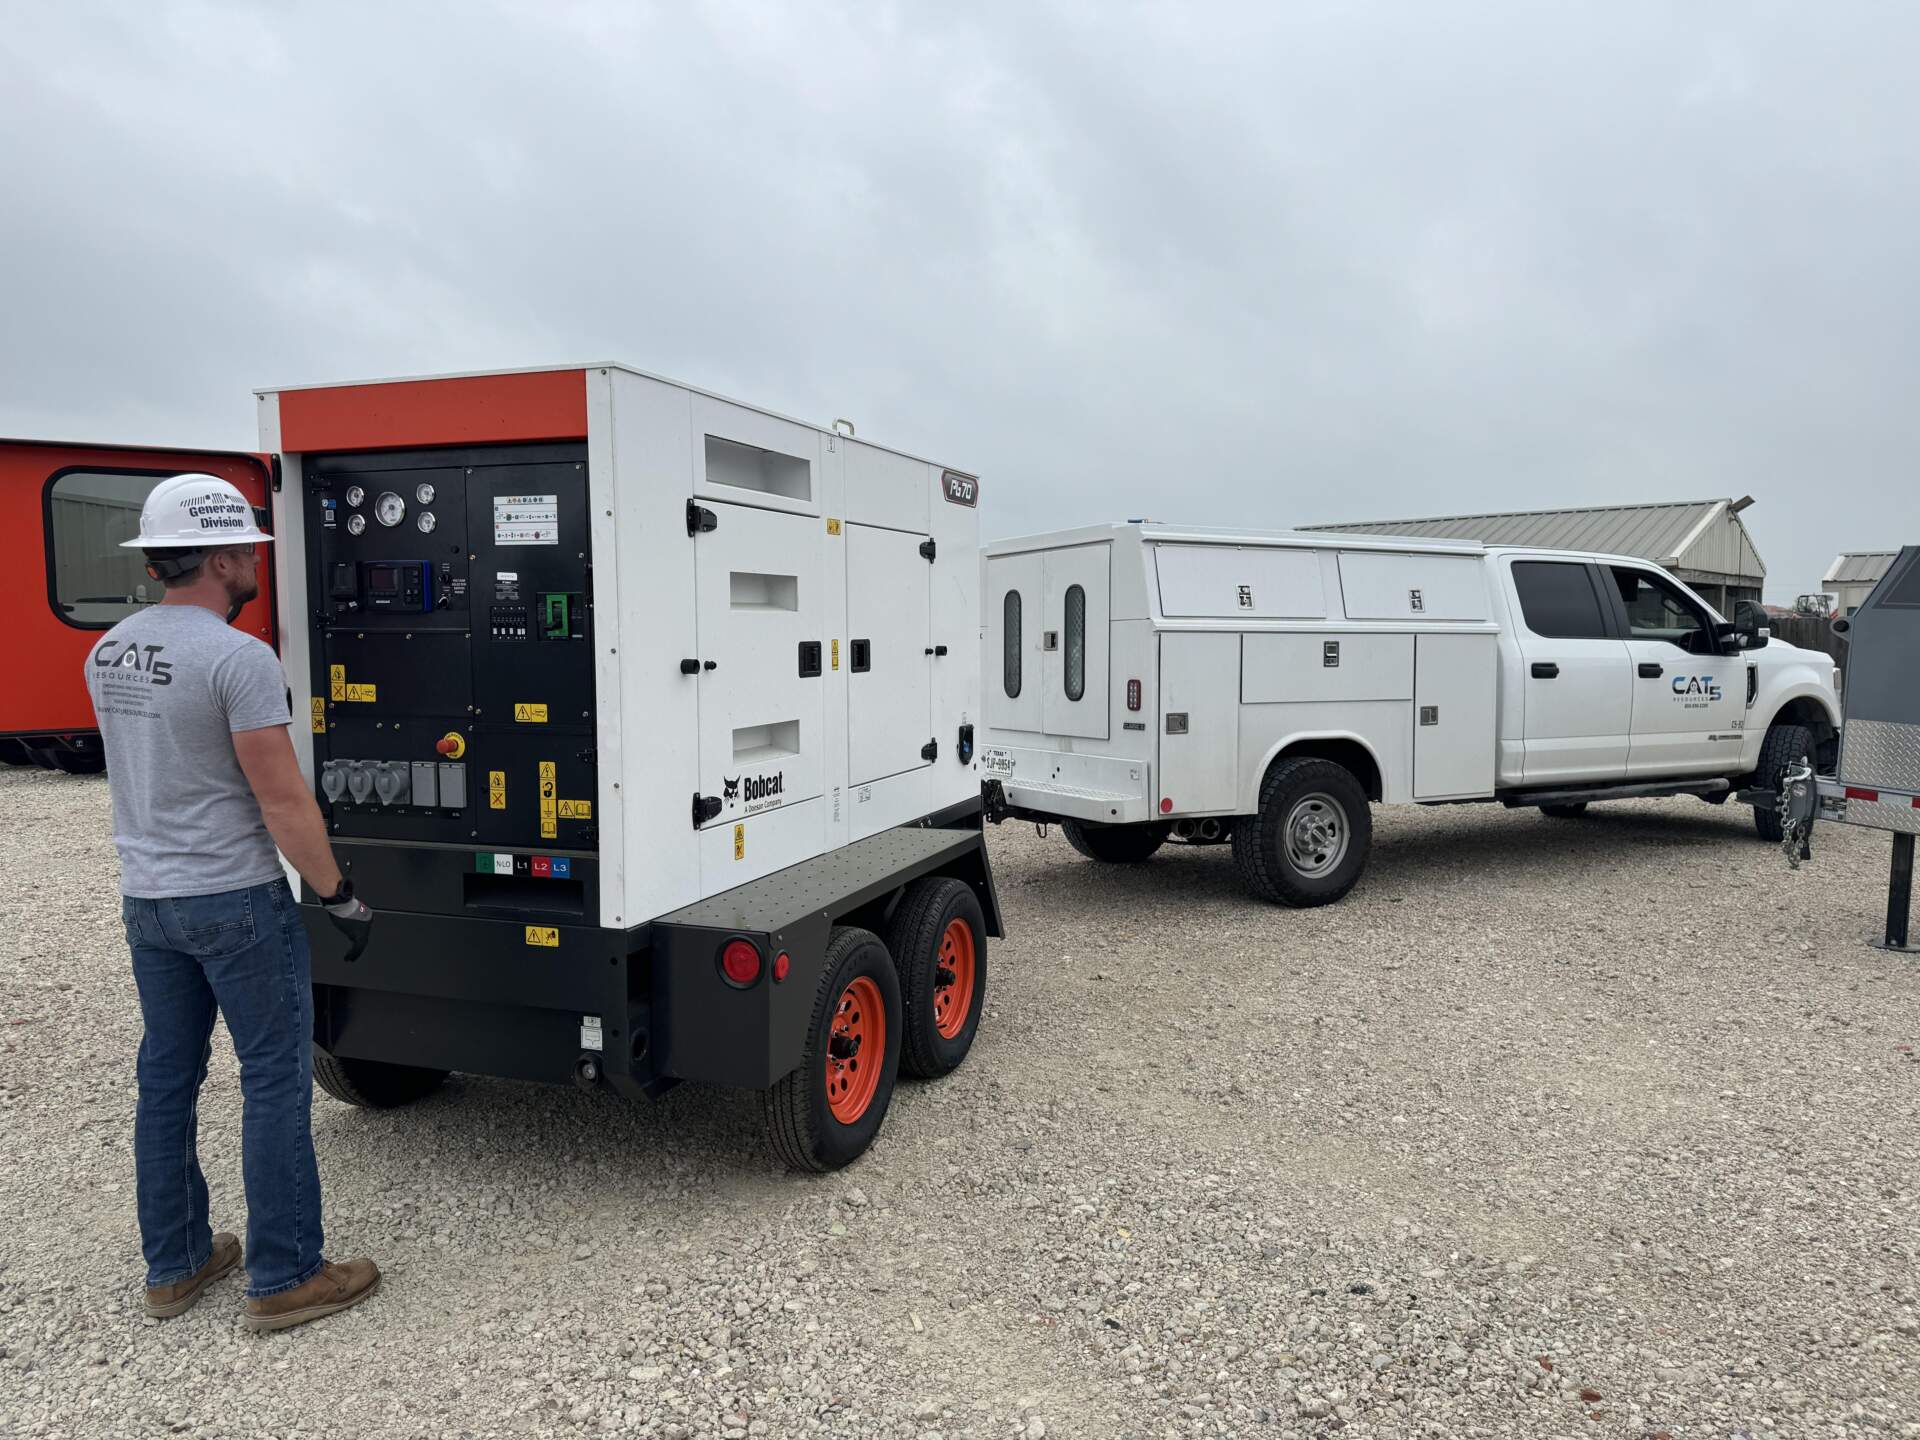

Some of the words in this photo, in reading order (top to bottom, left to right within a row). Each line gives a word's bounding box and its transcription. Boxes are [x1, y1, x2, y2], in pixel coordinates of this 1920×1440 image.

[949, 479, 973, 500] PG70
[189, 503, 246, 518] Generator
[200, 516, 245, 529] Division
[744, 770, 783, 802] Bobcat
[517, 861, 528, 870] L1
[534, 863, 548, 871] L2
[553, 864, 567, 872] L3
